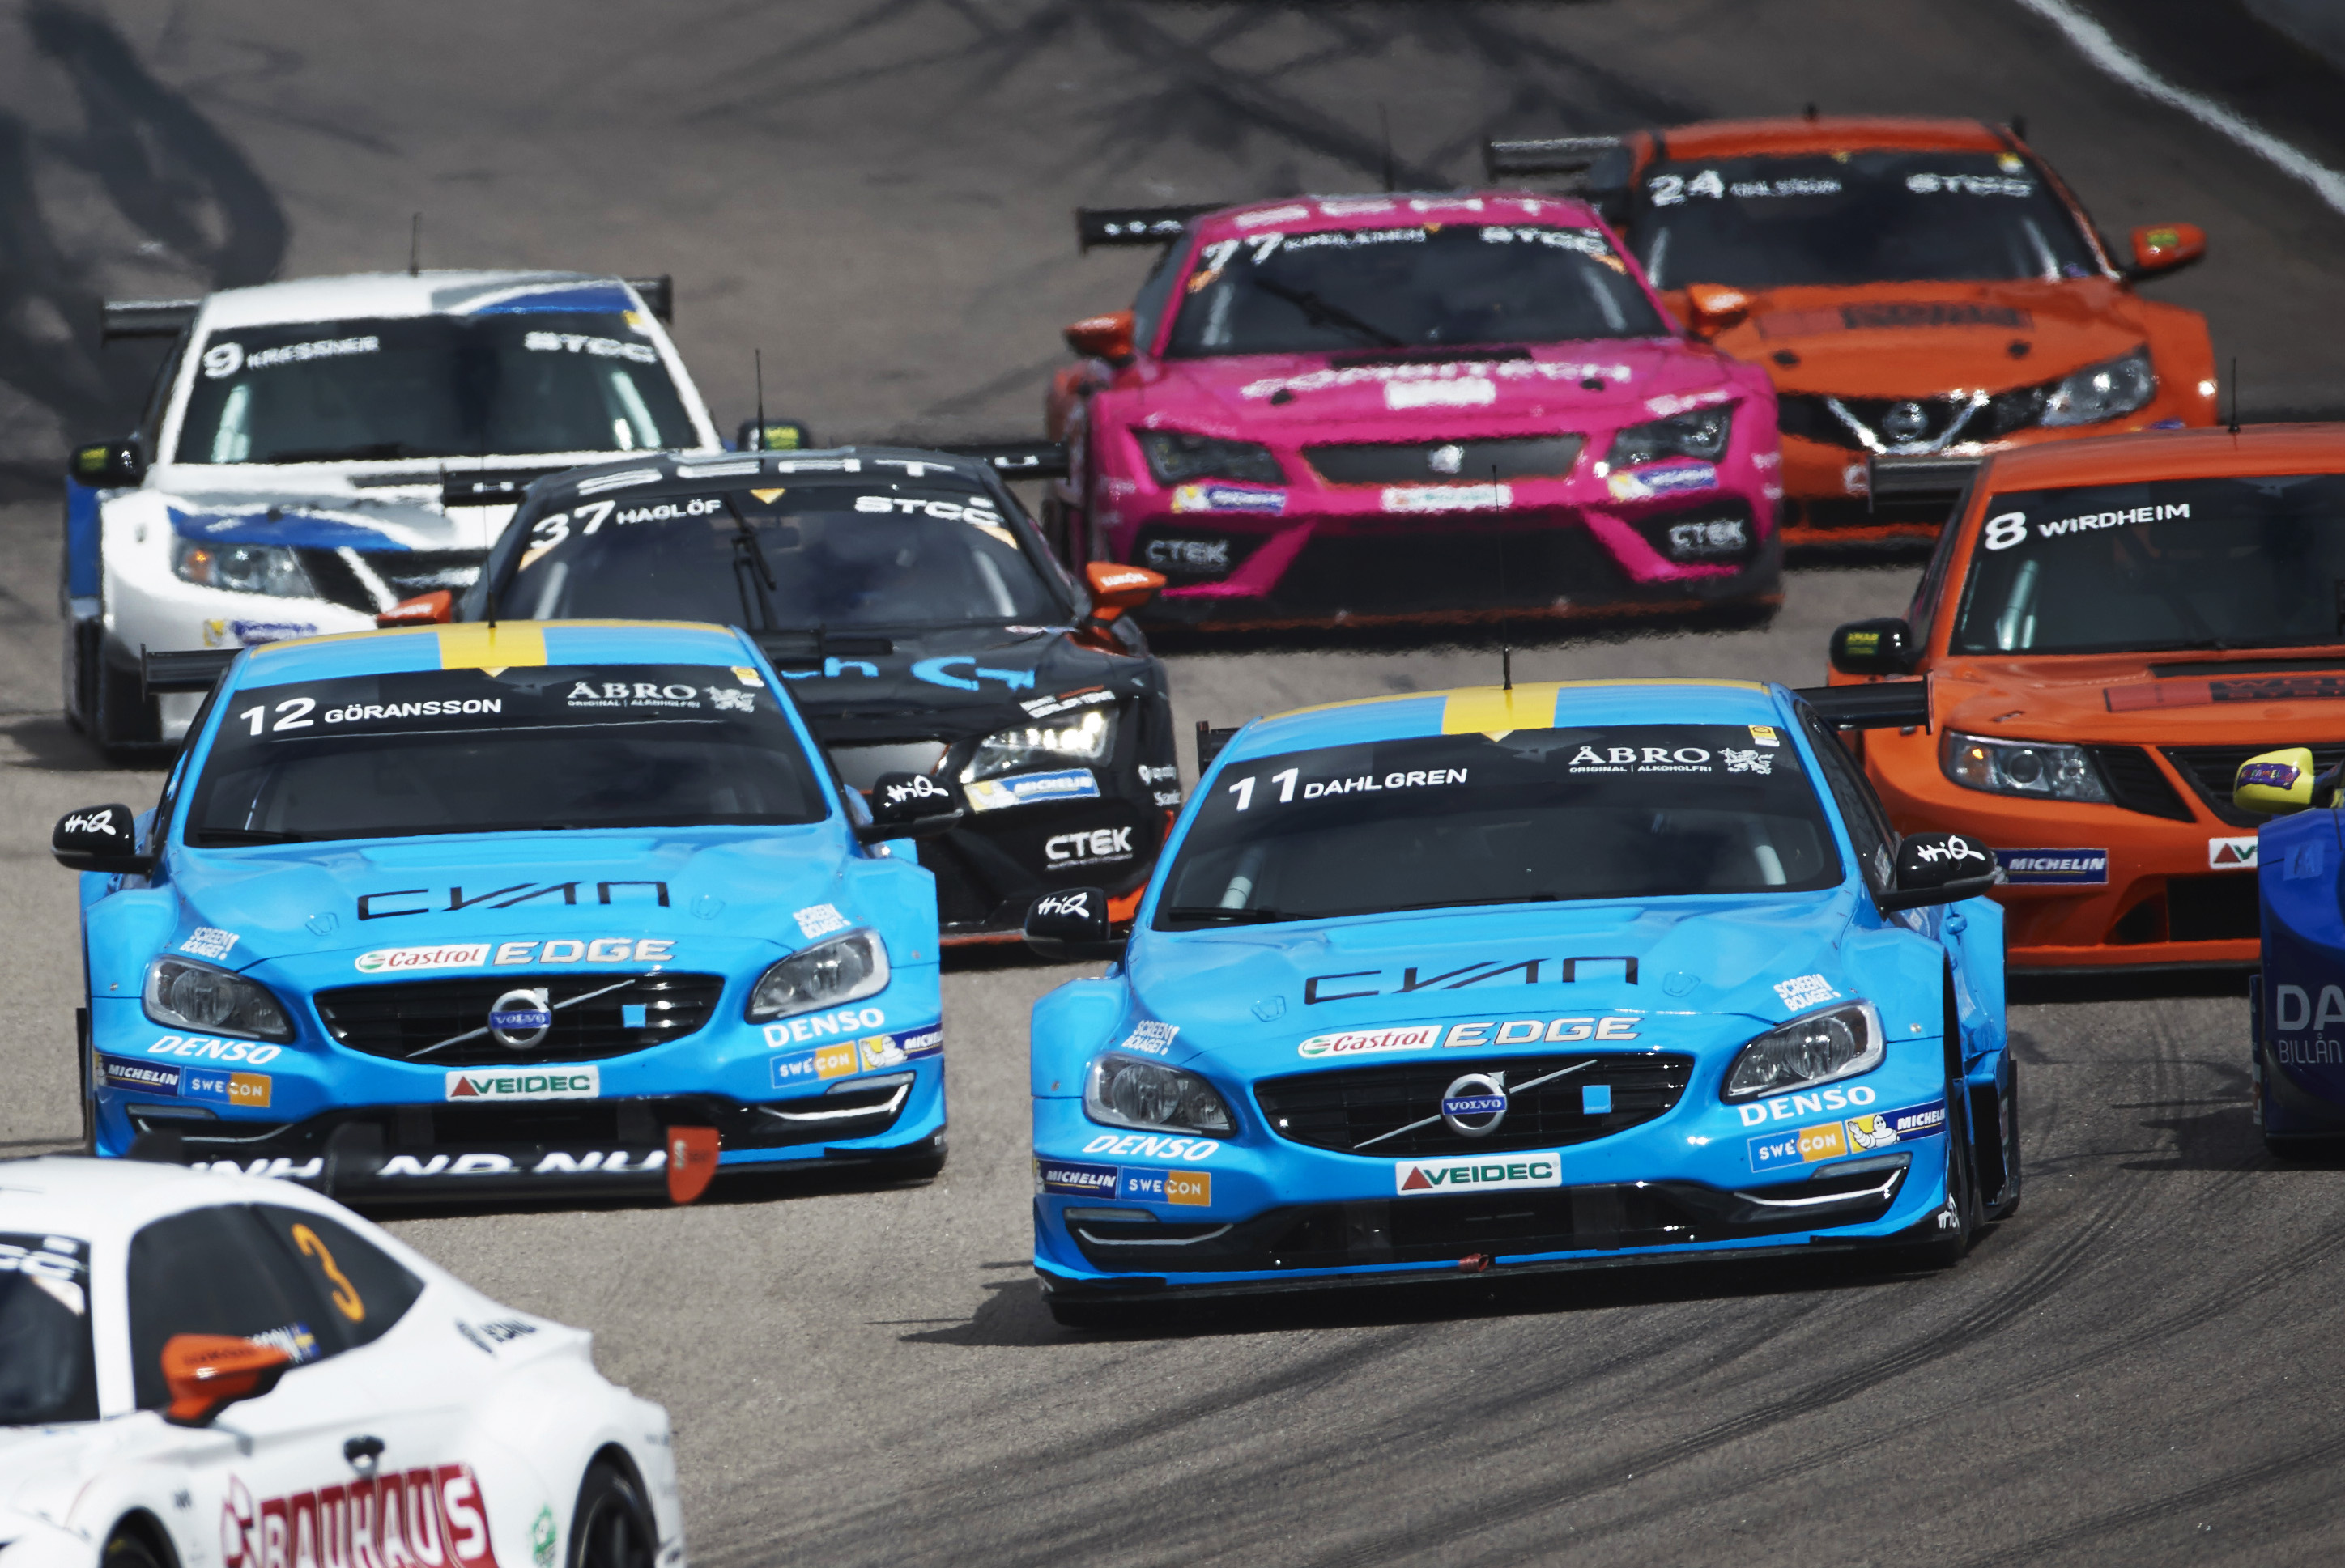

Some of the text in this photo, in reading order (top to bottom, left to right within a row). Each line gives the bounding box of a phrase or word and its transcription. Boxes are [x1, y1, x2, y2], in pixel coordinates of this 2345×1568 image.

[1647, 169, 1725, 207] 24
[203, 342, 244, 379] 9
[530, 499, 722, 550] 37 HAGLÖF
[854, 495, 1004, 527] STCC
[1985, 503, 2190, 550] 8 WIRDHEIM
[1145, 538, 1231, 566] CTEK
[567, 681, 697, 700] ÅBRO
[240, 696, 502, 736] 12 GÖRANSSON
[1568, 746, 1710, 765] ÅBRO
[1569, 765, 1713, 773] ORIGINAL ALKOHOLFRI
[887, 775, 949, 802] HiQ
[1229, 767, 1467, 811] 11 DAHLGREN
[65, 809, 117, 835] HiQ
[1045, 826, 1133, 860] CTEK
[1917, 835, 1985, 862] HiQ
[2008, 856, 2106, 872] MICHELIN
[1038, 891, 1090, 919] HiQ
[389, 937, 678, 967] Castrol EDGE
[496, 1013, 547, 1025] VOLVO
[763, 1007, 885, 1048] DENSO
[903, 1030, 943, 1050] MICHE
[1332, 1016, 1645, 1052] Castrol EDGE
[2279, 1032, 2343, 1064] BILLÅN
[147, 1035, 282, 1064] DENSO
[107, 1064, 179, 1086] MICHELIN
[470, 1074, 591, 1094] VEIDEC
[1446, 1098, 1502, 1111] VOLVO
[1737, 1086, 1876, 1126] DENSO
[1082, 1135, 1219, 1161] DENSO
[1046, 1170, 1117, 1188] MICHELIN
[1424, 1162, 1554, 1186] VEIDEC
[291, 1222, 366, 1324] 3
[263, 1476, 486, 1568] BAUHAUS
